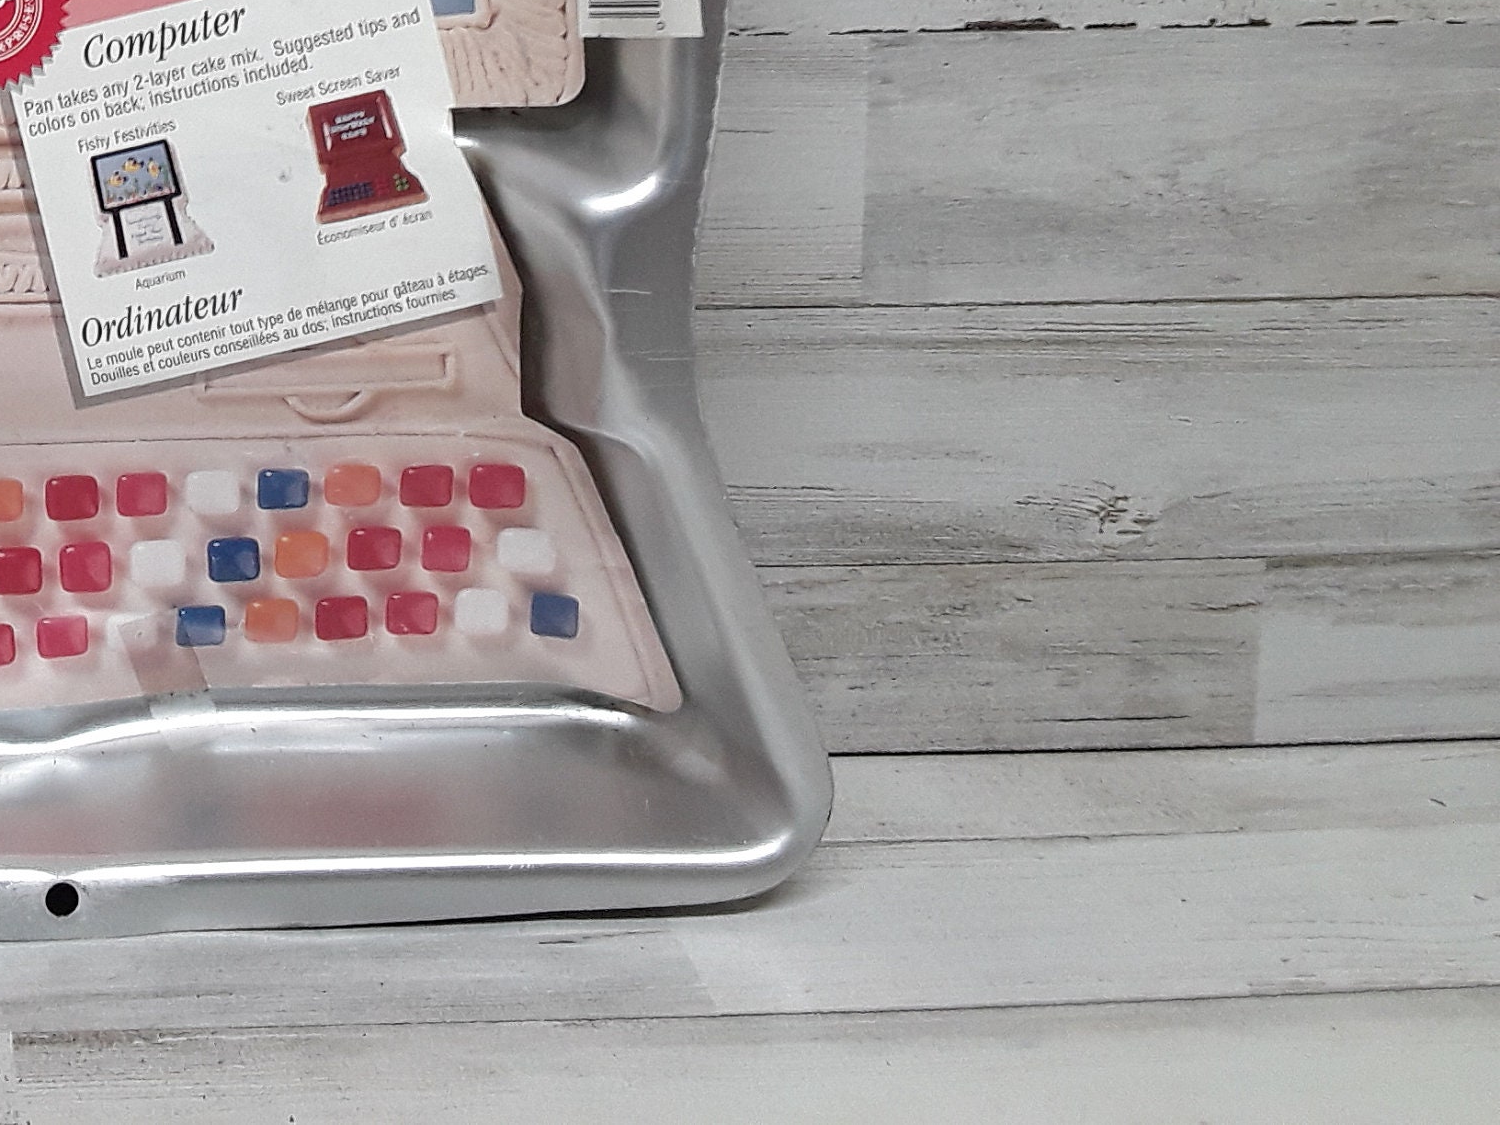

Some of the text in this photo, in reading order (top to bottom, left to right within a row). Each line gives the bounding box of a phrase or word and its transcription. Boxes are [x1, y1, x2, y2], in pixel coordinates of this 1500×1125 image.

[24, 7, 421, 118] Pan takes any 2-layer cake mix. Suggested tips and
[83, 7, 246, 68] Computer
[28, 55, 314, 137] colors on back; instructions included.
[276, 65, 401, 106] Sweet Screen Saver
[77, 119, 177, 154] Fishy Festivities
[135, 268, 186, 291] Aquarium
[81, 288, 243, 348] Ordinateur
[87, 356, 103, 371] Le
[106, 345, 145, 367] moule
[147, 338, 175, 361] peut
[177, 325, 227, 349] contenir
[229, 319, 255, 336] tout
[257, 311, 284, 332] type
[287, 306, 302, 323] de
[306, 295, 358, 319] mélange
[361, 287, 389, 308] pour
[393, 276, 434, 301] gâteau
[437, 272, 445, 287] à
[90, 364, 140, 386] Douilles
[143, 360, 155, 374] et
[157, 347, 211, 371] couleurs
[213, 330, 281, 357] conseillées
[283, 328, 299, 340] au
[331, 301, 403, 329] instructions
